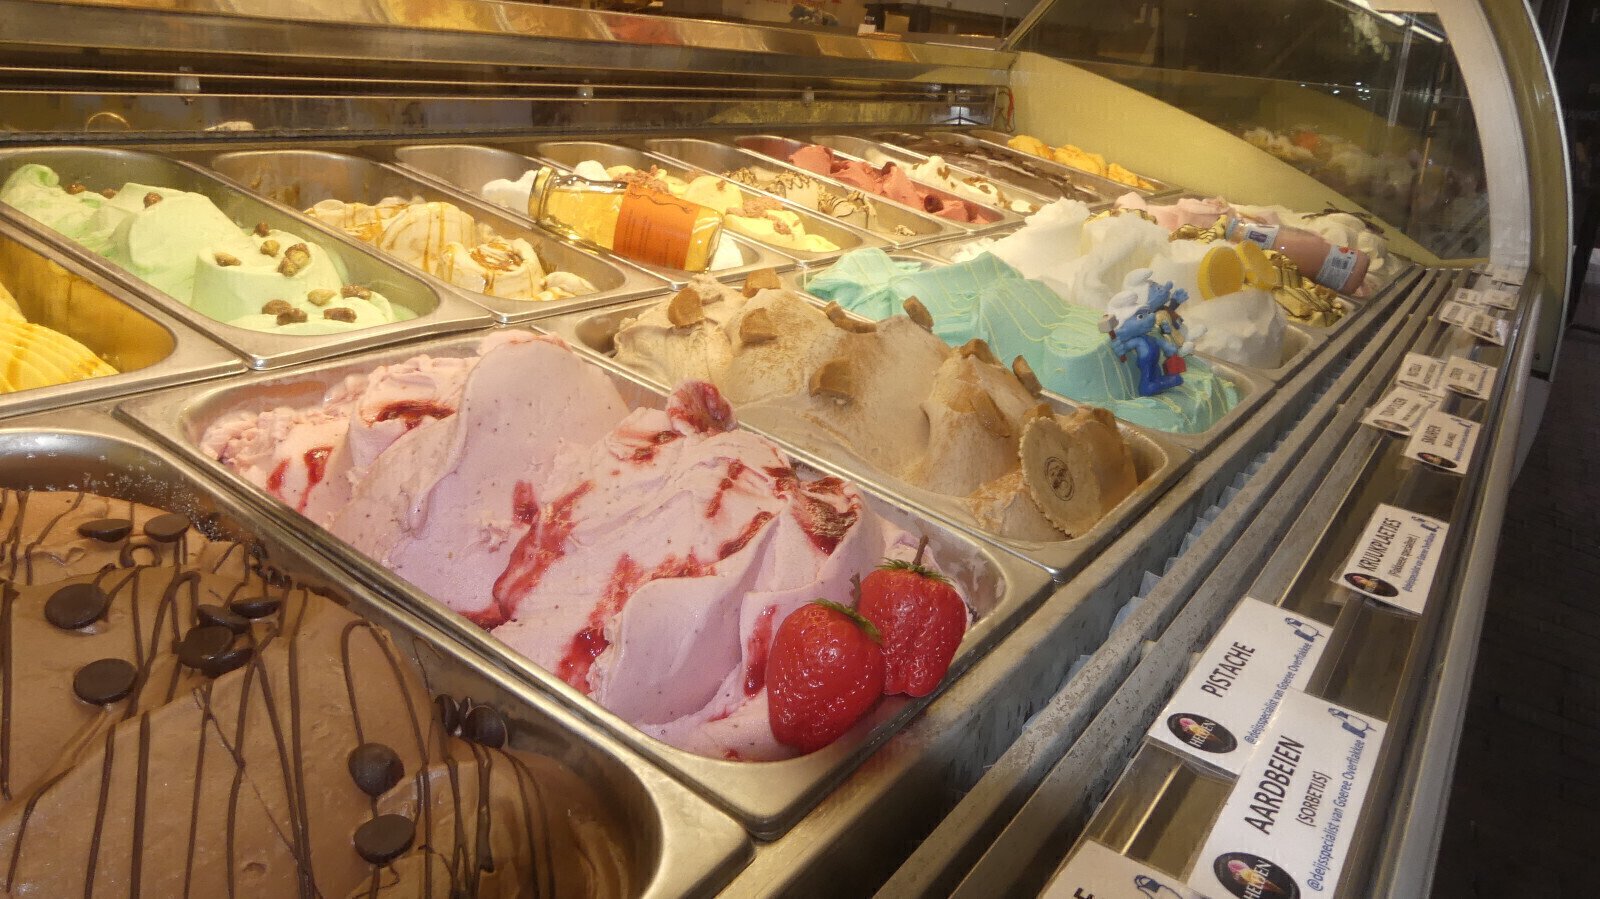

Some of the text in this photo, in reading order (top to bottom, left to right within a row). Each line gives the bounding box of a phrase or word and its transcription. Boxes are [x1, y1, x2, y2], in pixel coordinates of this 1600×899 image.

[1357, 517, 1402, 572] KRUUKPLAETJES
[1200, 641, 1256, 698] PISTACHE
[1244, 642, 1312, 744] @deijsspecialist van Goeree Overflakkee
[1243, 735, 1305, 836] AARDBEIEN
[1295, 770, 1333, 828] (SORBETIJS)
[1307, 739, 1366, 892] @deijsspecialist van Goeree Overflakkee
